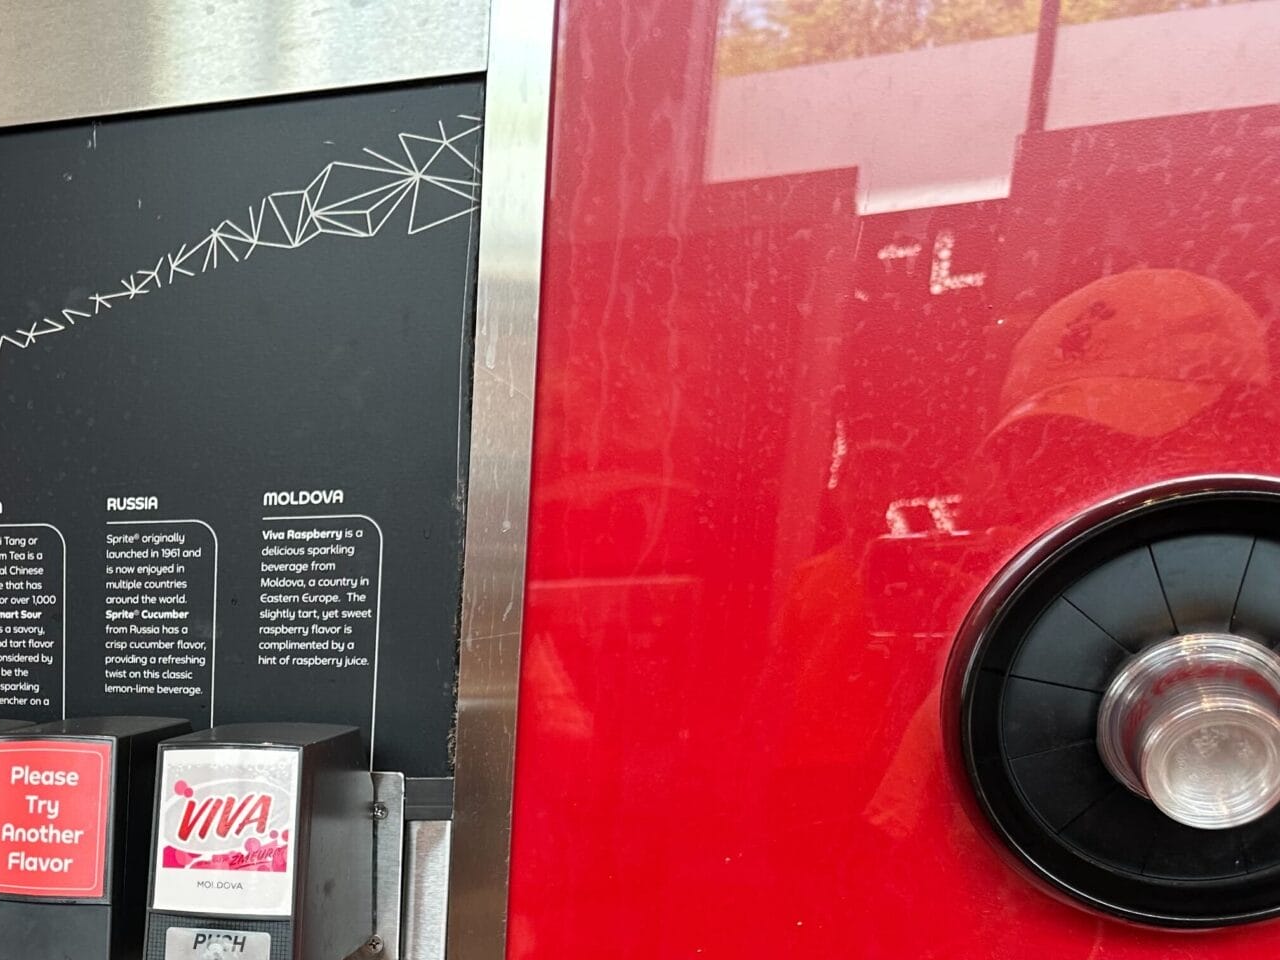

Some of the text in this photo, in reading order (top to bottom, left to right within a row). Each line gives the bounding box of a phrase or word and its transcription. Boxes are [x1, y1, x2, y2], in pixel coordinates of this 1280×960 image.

[106, 496, 158, 511] RUSSIA
[263, 490, 344, 506] MOLDOVA
[141, 532, 185, 545] originally
[262, 528, 363, 541] Viva Raspberry is a
[3, 536, 26, 547] Tang
[27, 537, 38, 545] or
[8, 550, 25, 560] Tea
[27, 551, 34, 560] is
[36, 552, 43, 560] a
[106, 547, 201, 558] launched in 1961 and
[261, 544, 355, 557] delicious sparkling
[9, 565, 44, 575] Chinese
[105, 563, 185, 576] is now enjoyed in
[260, 560, 335, 574] beverage from
[5, 580, 24, 590] that
[25, 580, 42, 589] has
[105, 579, 187, 591] multiple countries
[260, 577, 306, 588] Moldova,
[317, 577, 358, 588] country
[360, 576, 369, 585] in
[31, 595, 56, 605] 1,000
[105, 594, 187, 604] around the world.
[259, 592, 366, 604] Eastern Europe. The
[141, 609, 189, 619] Cucumber
[259, 608, 372, 620] slightly tart, yet sweet
[11, 765, 80, 787] Please
[25, 795, 60, 820] Try
[177, 794, 273, 842] VIVA
[1, 822, 84, 845] Another
[8, 851, 74, 873] Flavor
